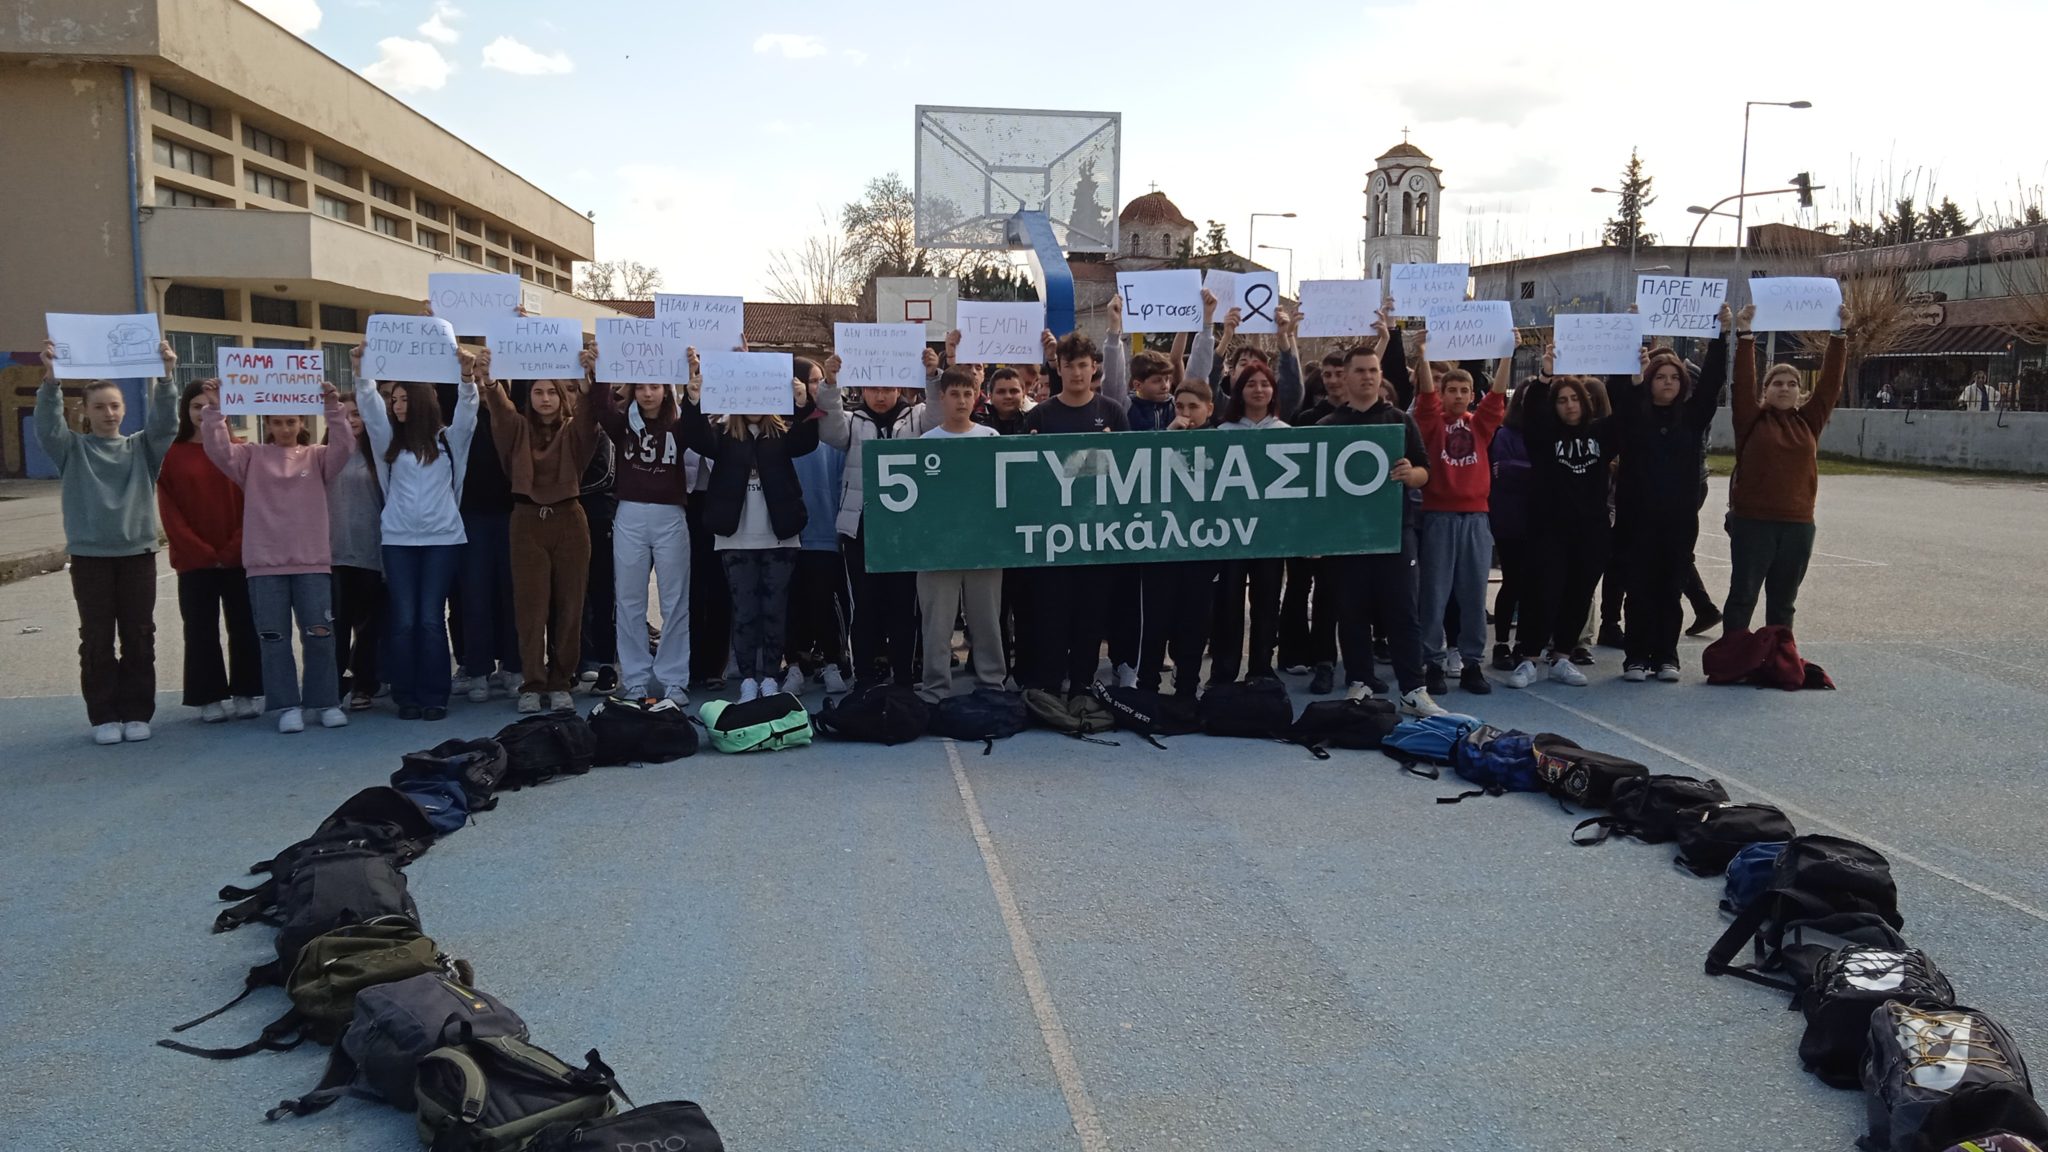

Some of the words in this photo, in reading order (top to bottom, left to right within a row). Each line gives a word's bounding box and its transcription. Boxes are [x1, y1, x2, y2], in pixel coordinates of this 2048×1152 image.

[1642, 279, 1693, 297] ΠΑΡΕ
[1700, 281, 1724, 298] ΜΕ
[659, 298, 690, 313] ΗΤΑΝ
[704, 303, 737, 315] ΚΑΚΙΑ
[1783, 299, 1823, 312] ΑΙΜΑ
[421, 323, 448, 336] ΚΑΙ
[516, 321, 560, 335] ΗΤΑΝ
[608, 319, 655, 338] ΠΑΡΕ
[661, 321, 681, 340] ΜΕ
[961, 316, 1028, 335] ΤΕΜΠΗ
[1429, 319, 1450, 331] ΟΧΙ
[368, 337, 404, 354] ΟΠΟΥ
[226, 353, 273, 369] ΜΑΜΑ
[287, 354, 322, 370] ΠΕΣ
[609, 359, 685, 378] ΦΤΑΣΕΙΣ
[227, 373, 259, 385] ΤΟΝ
[265, 373, 322, 385] ΜΠΑΜΠΑ
[226, 393, 244, 405] ΝΑ
[995, 440, 1390, 509] ΓΥΜΝΑΣΙΟ
[1015, 510, 1259, 562] τρικάλων
